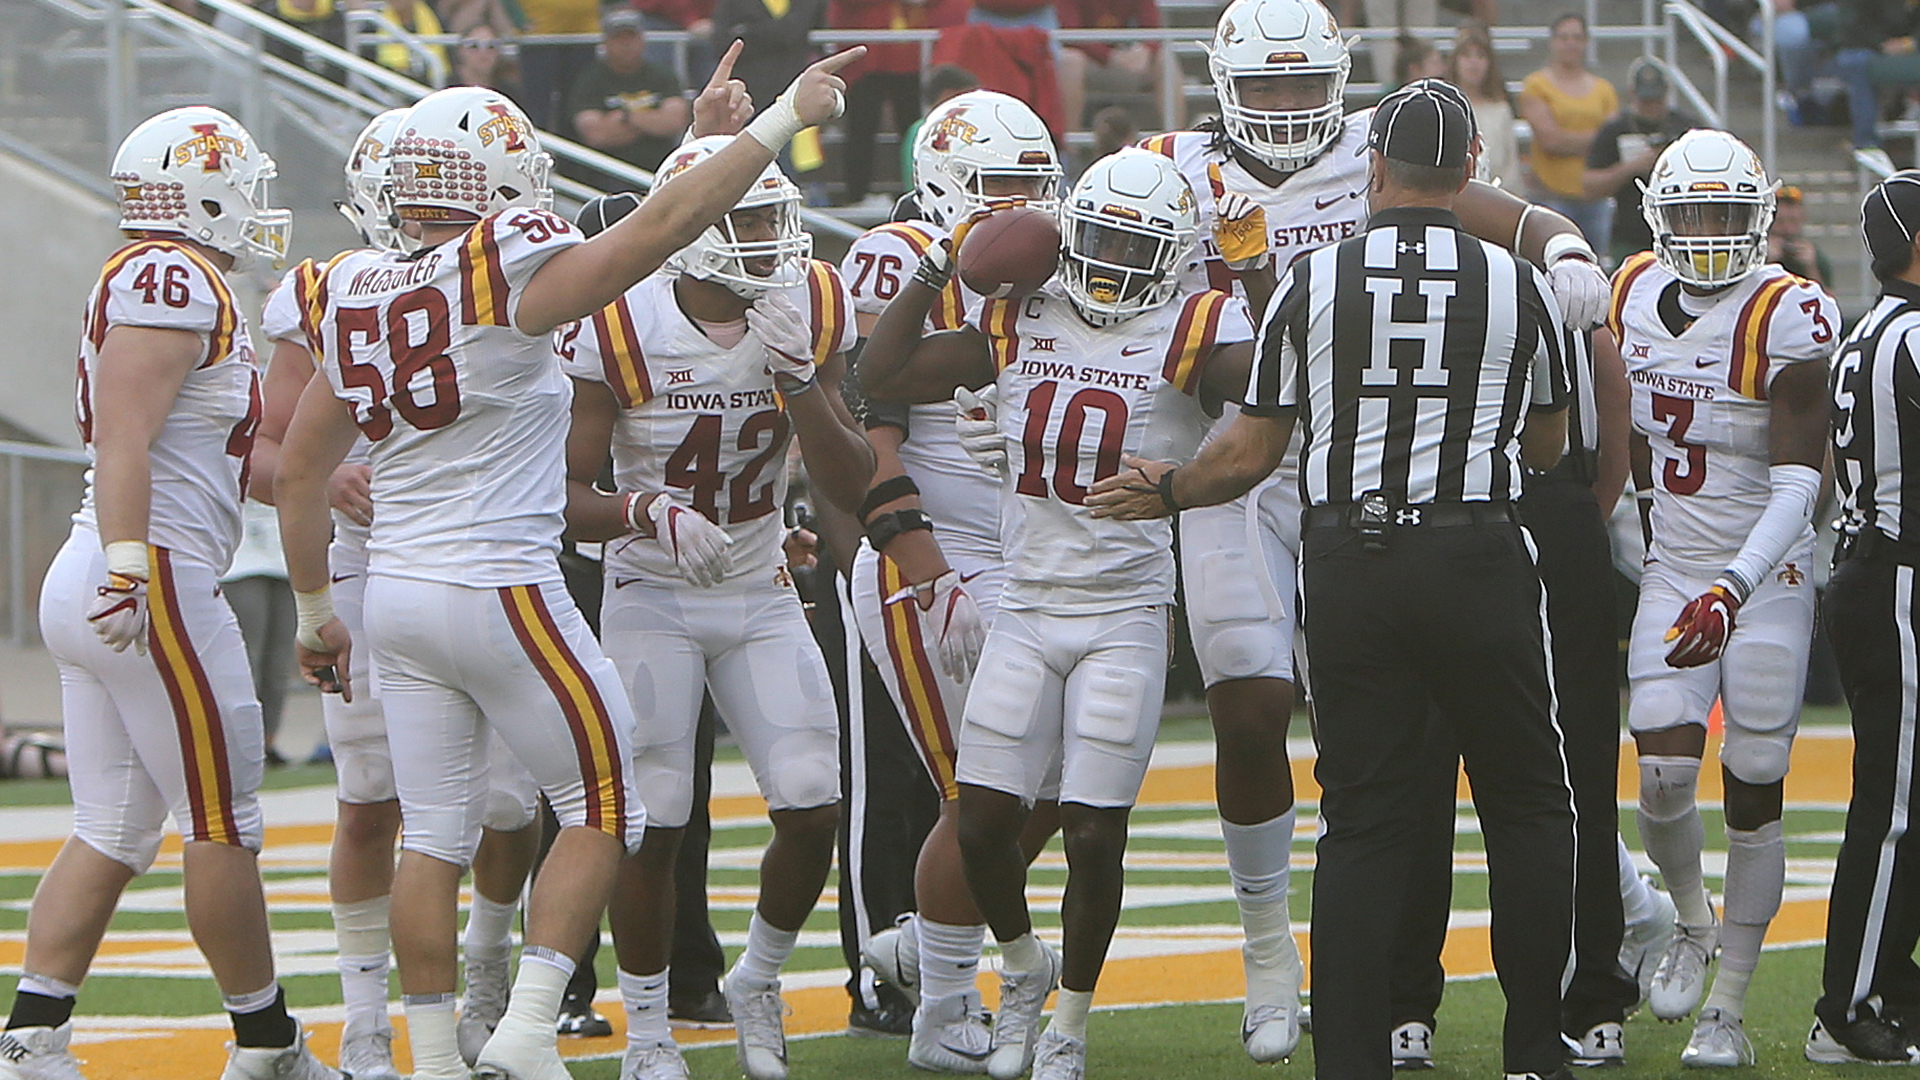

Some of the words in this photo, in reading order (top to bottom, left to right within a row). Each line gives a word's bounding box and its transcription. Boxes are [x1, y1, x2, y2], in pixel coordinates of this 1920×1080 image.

[509, 209, 570, 244] 58
[1274, 220, 1356, 248] STATE
[133, 263, 190, 309] 46
[851, 252, 902, 300] 76
[1026, 296, 1045, 319] C
[1798, 298, 1833, 343] 3
[553, 319, 582, 362] 2
[1362, 276, 1457, 386] H
[336, 286, 461, 442] 58
[1020, 360, 1075, 380] IOWA
[1079, 368, 1150, 391] STATE
[1631, 370, 1666, 391] IOWA
[1667, 379, 1715, 400] STATE
[666, 392, 726, 410] IOWA
[730, 389, 775, 409] STAT
[1016, 380, 1129, 506] 10
[1651, 392, 1707, 496] 3
[664, 410, 790, 525] 42
